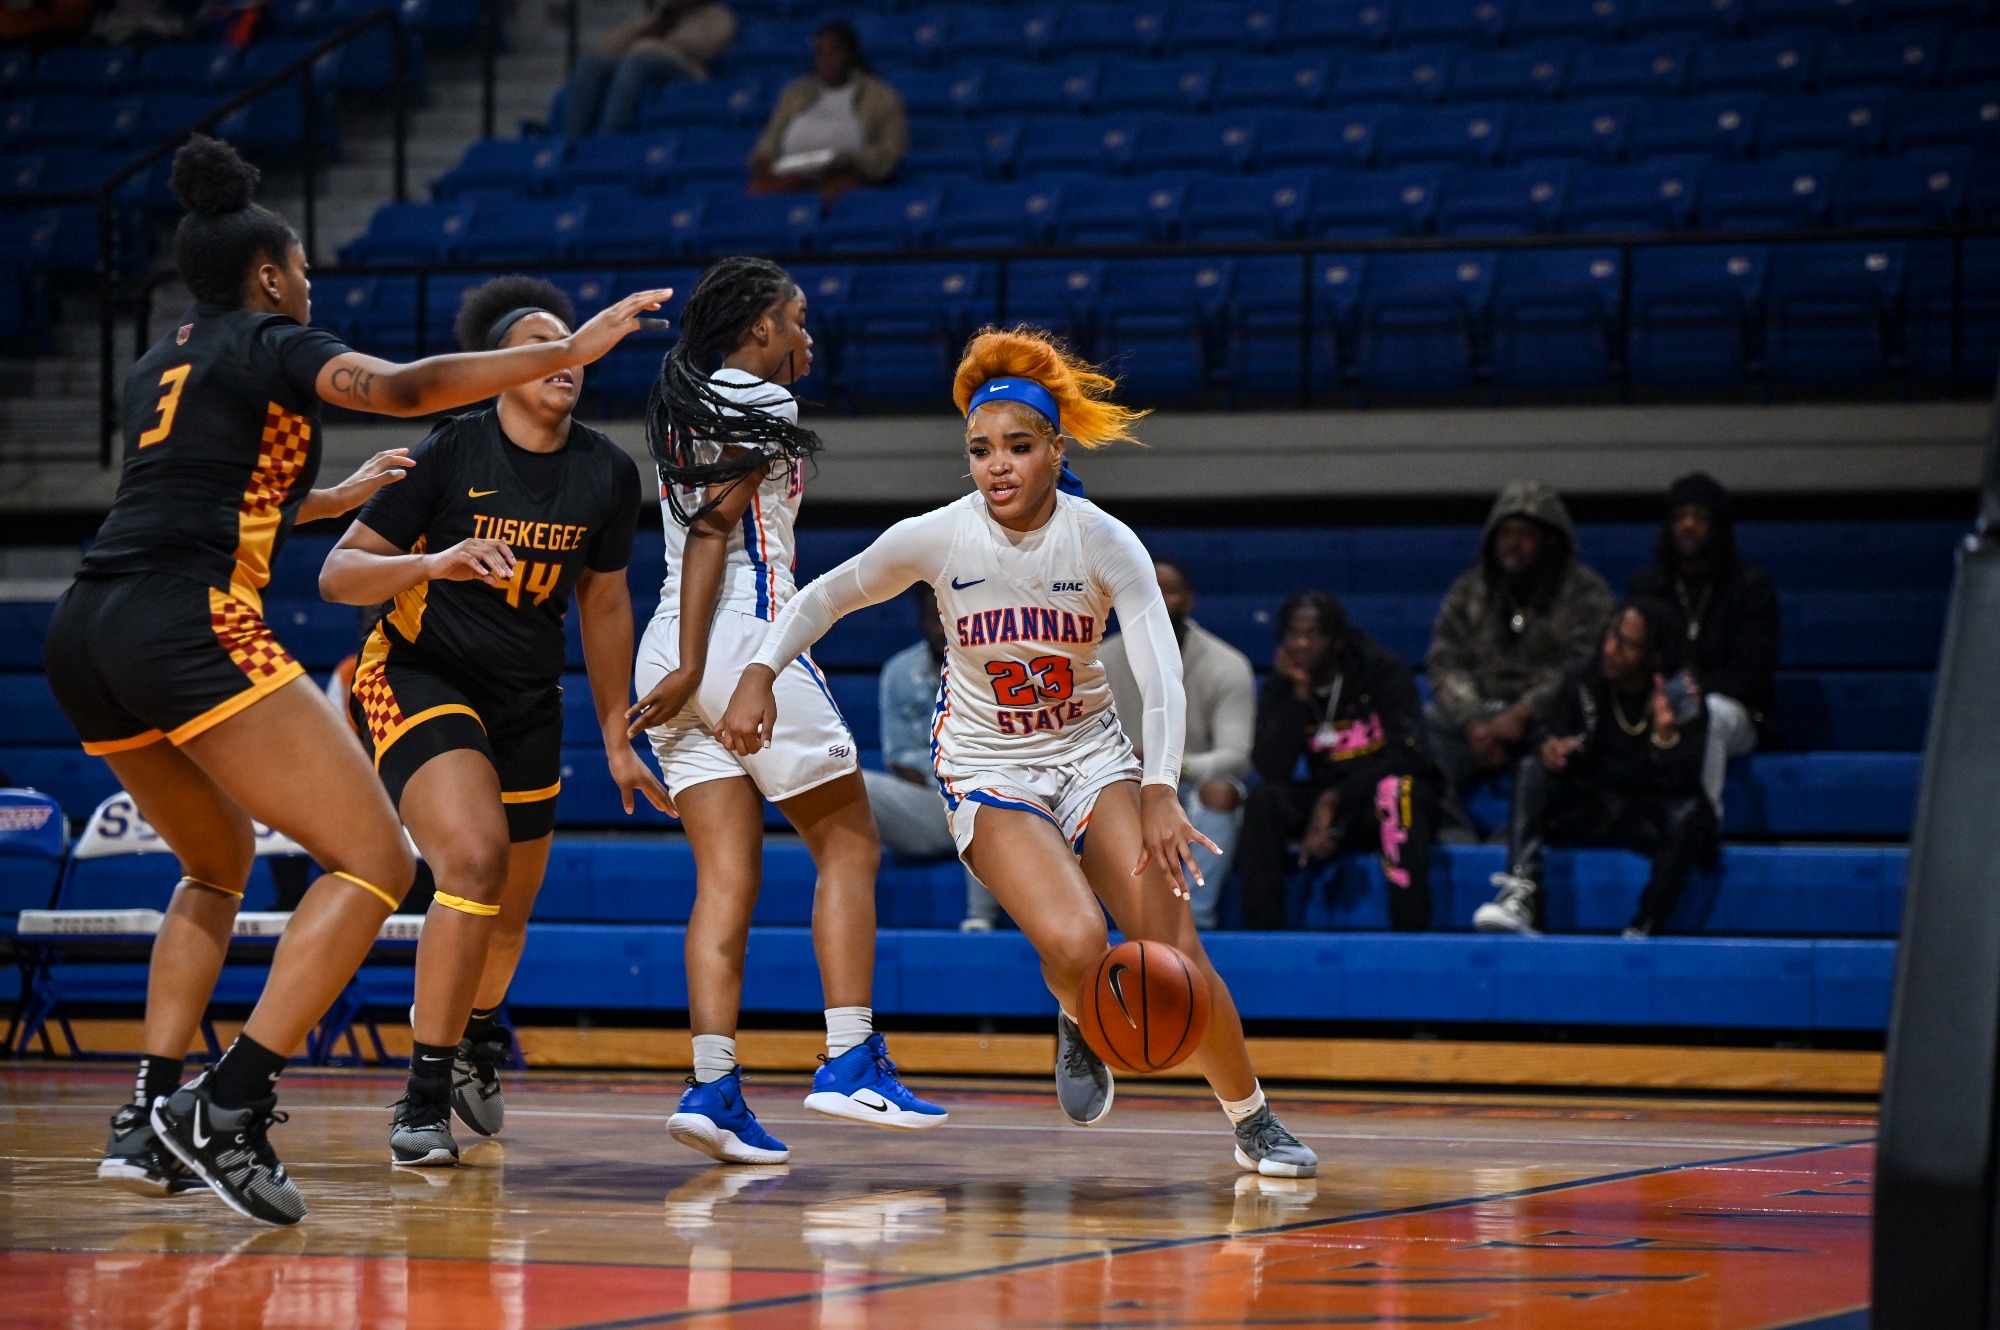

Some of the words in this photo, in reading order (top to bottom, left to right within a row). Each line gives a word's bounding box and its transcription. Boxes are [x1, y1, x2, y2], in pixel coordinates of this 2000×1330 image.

[138, 363, 192, 449] 3
[473, 514, 588, 551] TUSKEGEE
[1052, 582, 1083, 592] SIAC
[957, 607, 1094, 647] SAVANNAH
[984, 655, 1074, 706] 23
[997, 700, 1083, 734] STATE
